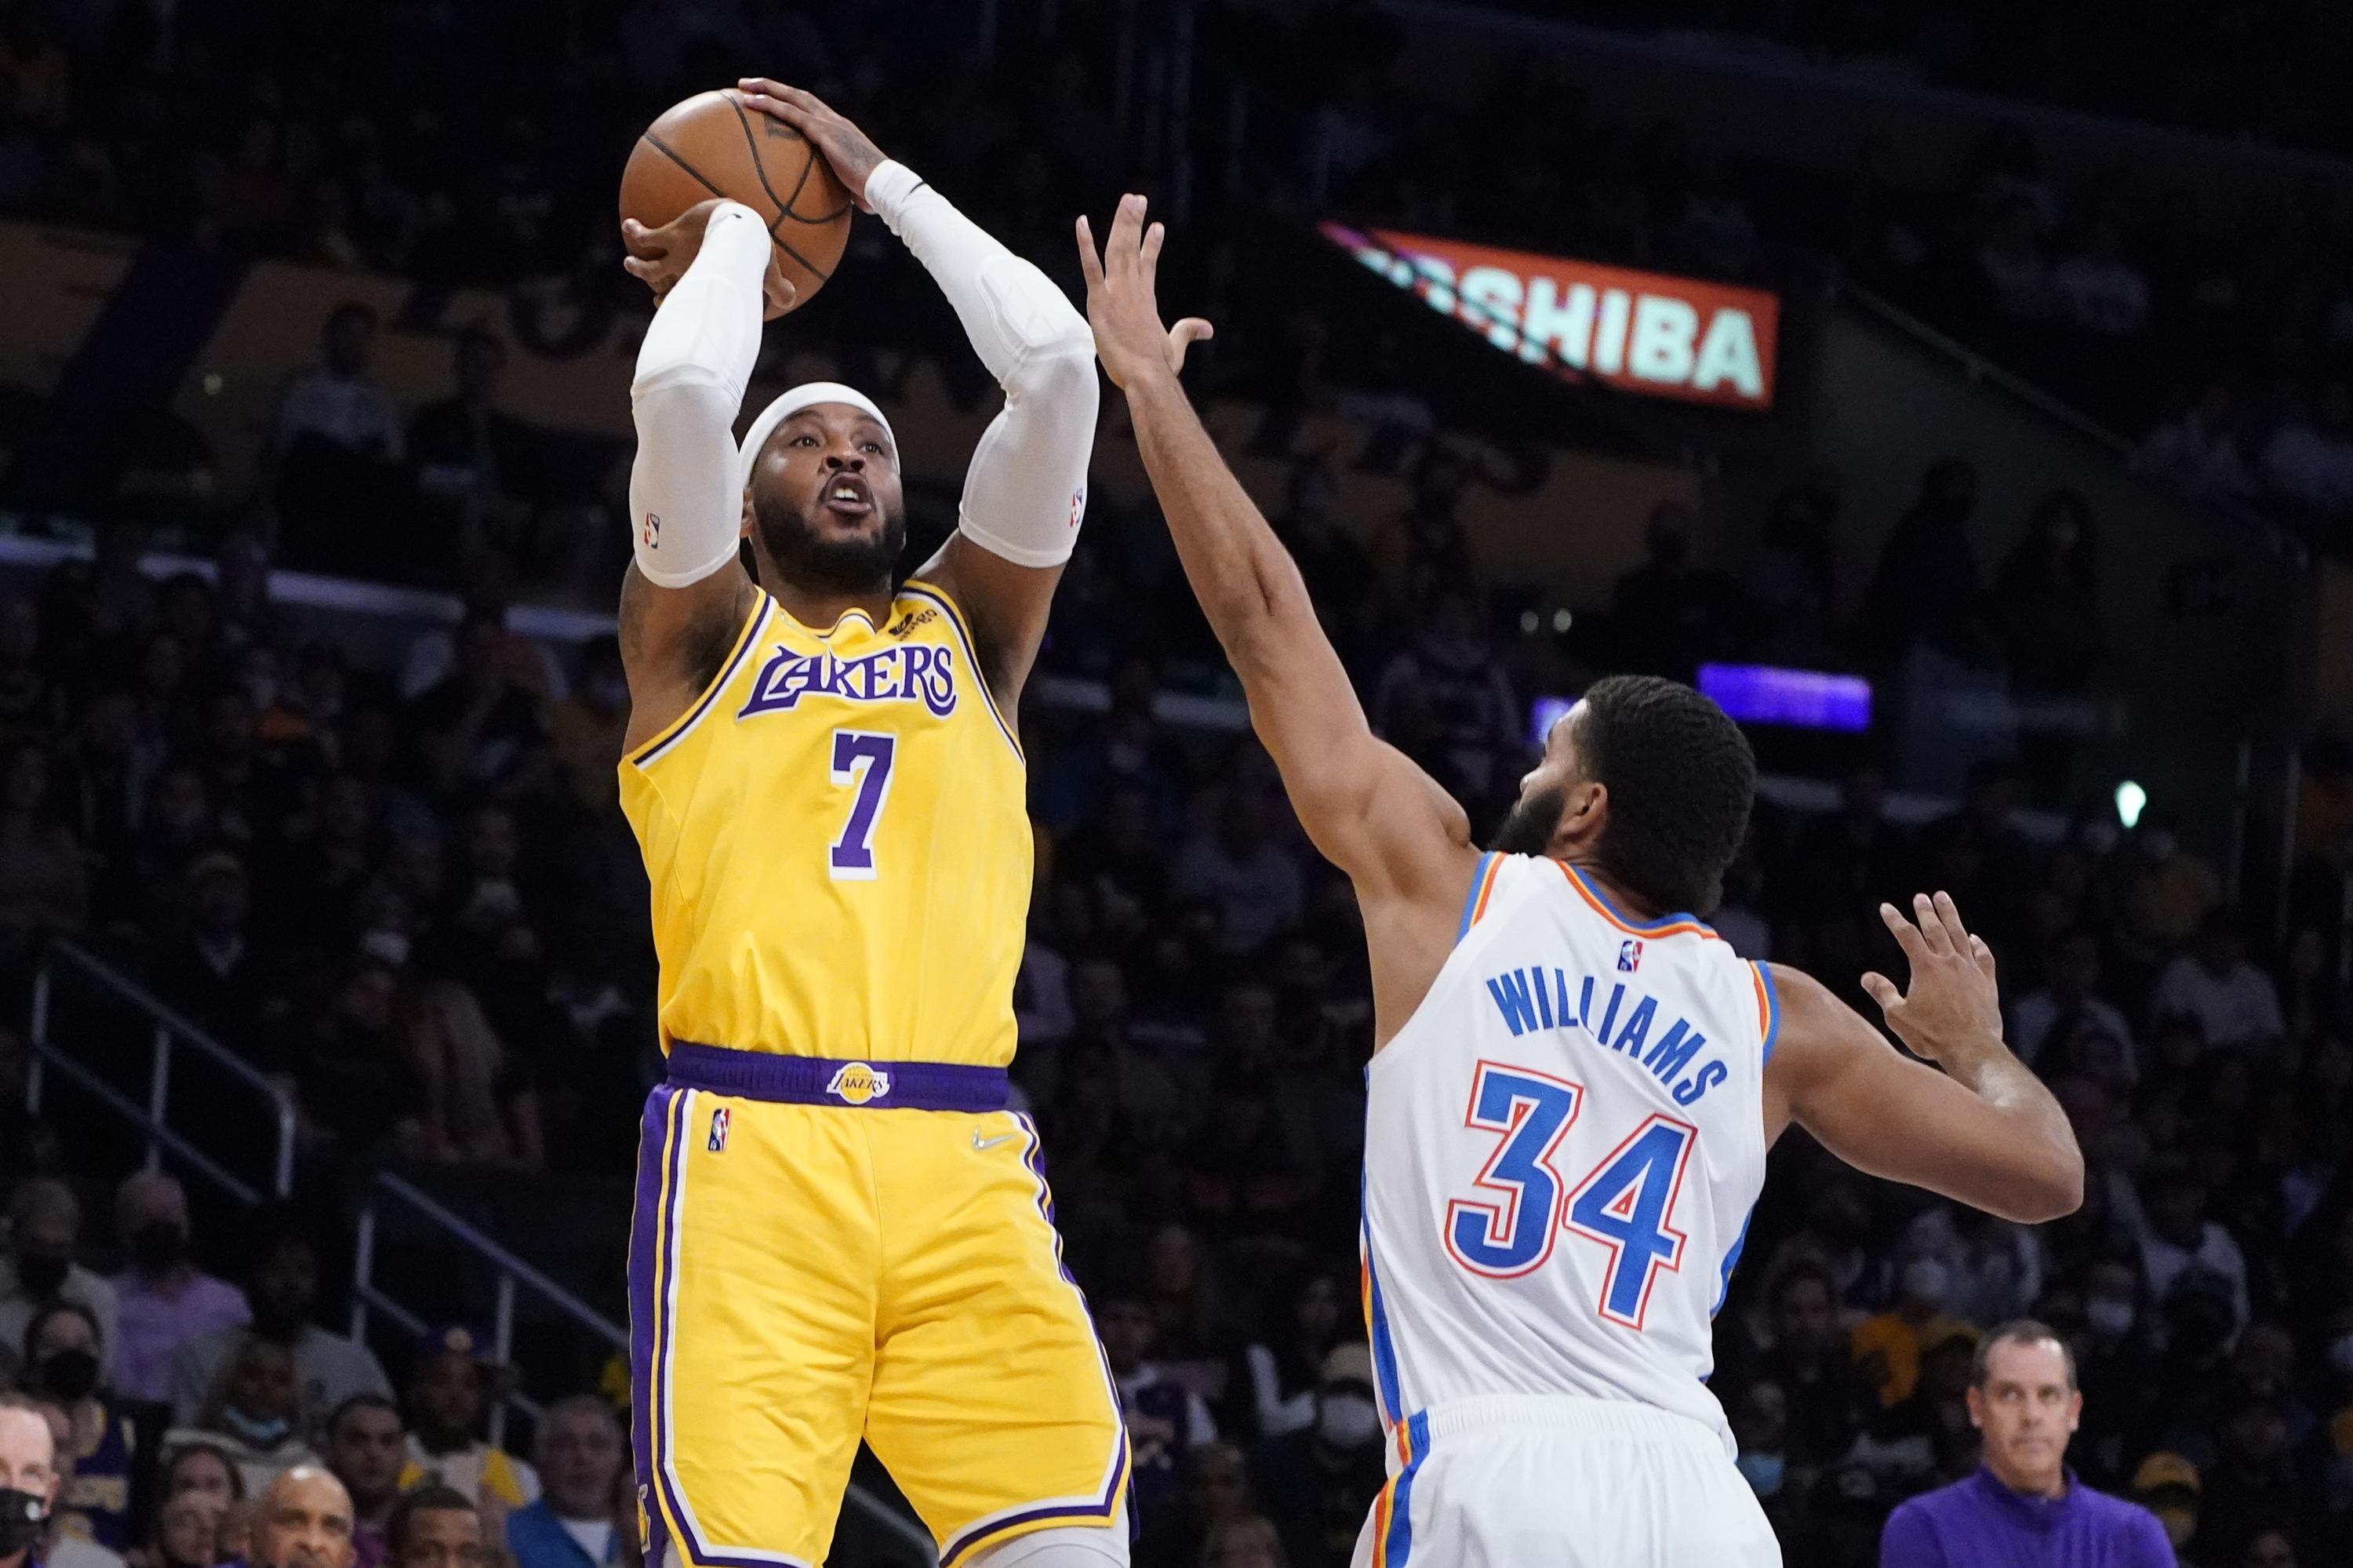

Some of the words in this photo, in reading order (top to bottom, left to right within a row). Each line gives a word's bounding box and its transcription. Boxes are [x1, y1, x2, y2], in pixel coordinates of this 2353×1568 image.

[1355, 247, 1762, 398] SHIBA
[735, 643, 958, 719] LAKERS
[830, 729, 896, 879] 7
[1486, 966, 1728, 1107] WILLIAMS
[1444, 1059, 1699, 1331] 34
